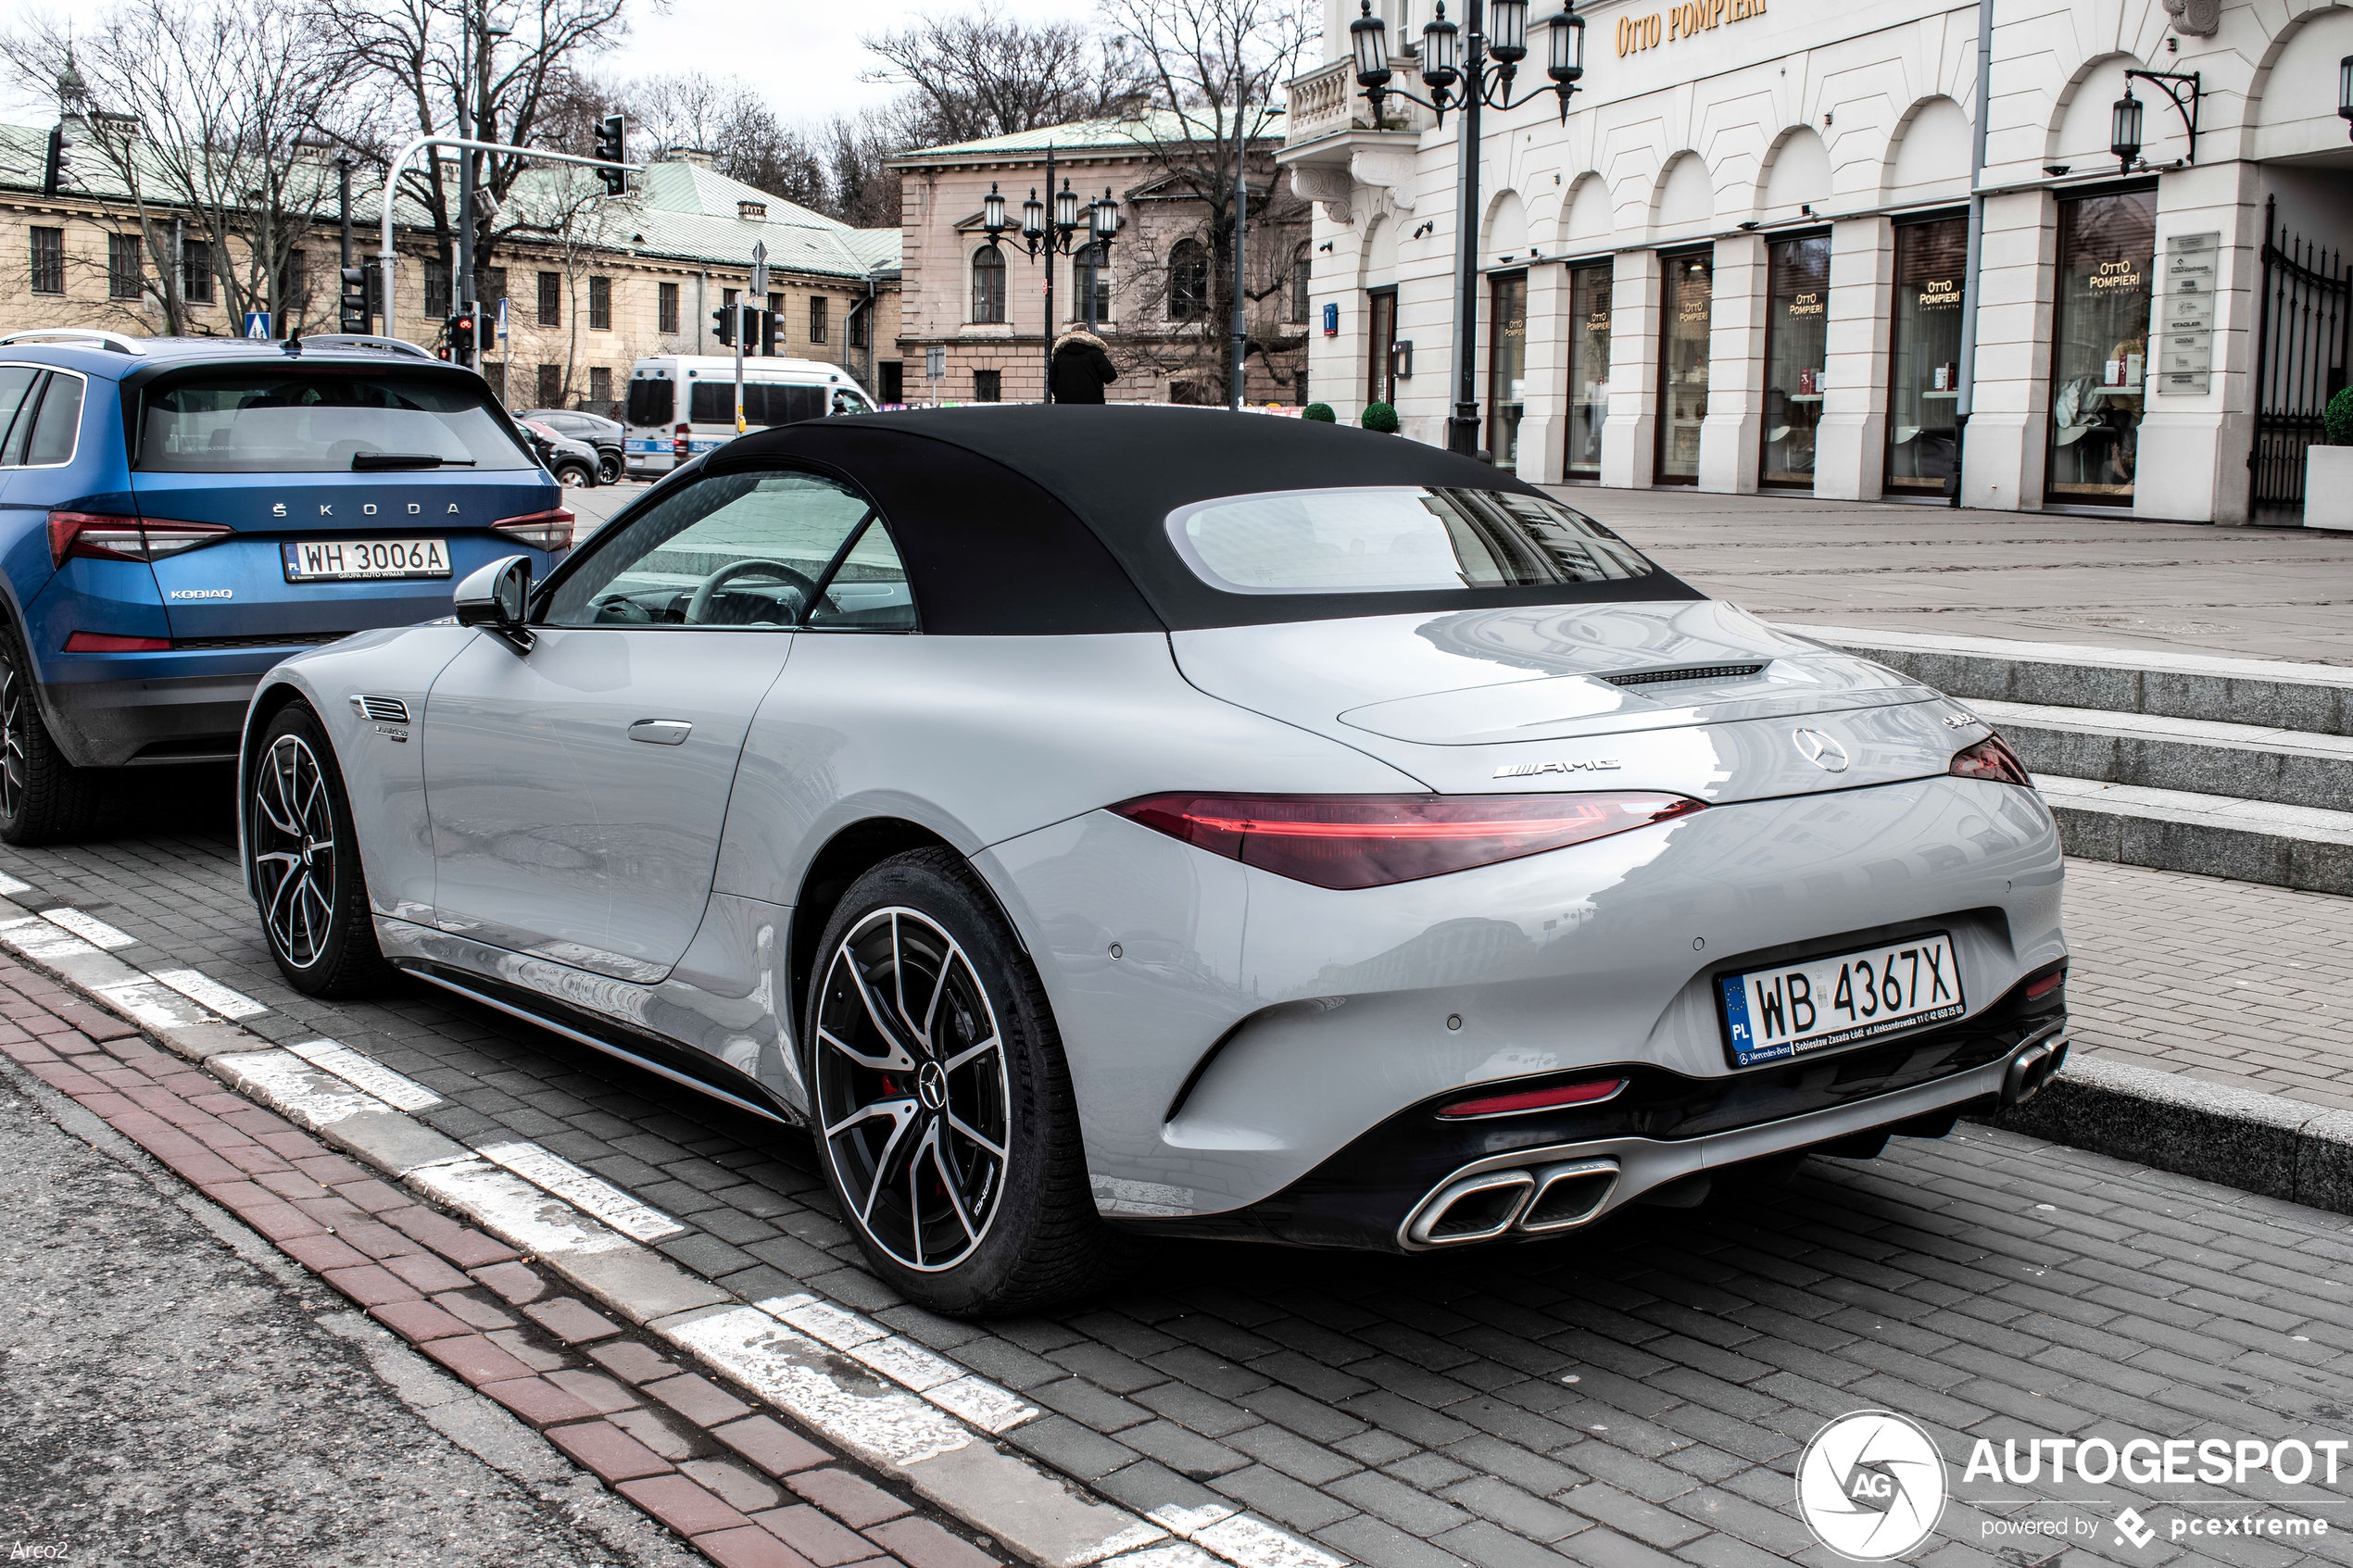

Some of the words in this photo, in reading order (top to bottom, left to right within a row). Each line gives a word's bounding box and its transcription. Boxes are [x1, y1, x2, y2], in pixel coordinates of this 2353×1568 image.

[1615, 13, 1661, 57] OTTO
[2100, 260, 2131, 275] OTTO
[1928, 280, 1953, 293] OTTO
[2089, 271, 2141, 289] POMPIERI
[1795, 293, 1817, 305] OTTO
[1919, 290, 1960, 305] POMPIERI
[1685, 301, 1704, 313] OTTO
[1789, 302, 1823, 315] POMPIERI
[1592, 312, 1607, 322] OTTO
[272, 503, 459, 518] ŠKODA
[288, 563, 299, 571] PL
[305, 545, 345, 571] WH
[354, 543, 443, 570] 3006A
[170, 589, 233, 599] KODIAQ
[1732, 1023, 1750, 1041] PL
[1755, 972, 1817, 1039] WB
[1833, 944, 1951, 1022] 4367X
[1828, 1031, 1850, 1045] Zasada
[1917, 1013, 1924, 1024] 11
[1948, 1006, 1957, 1016] 25
